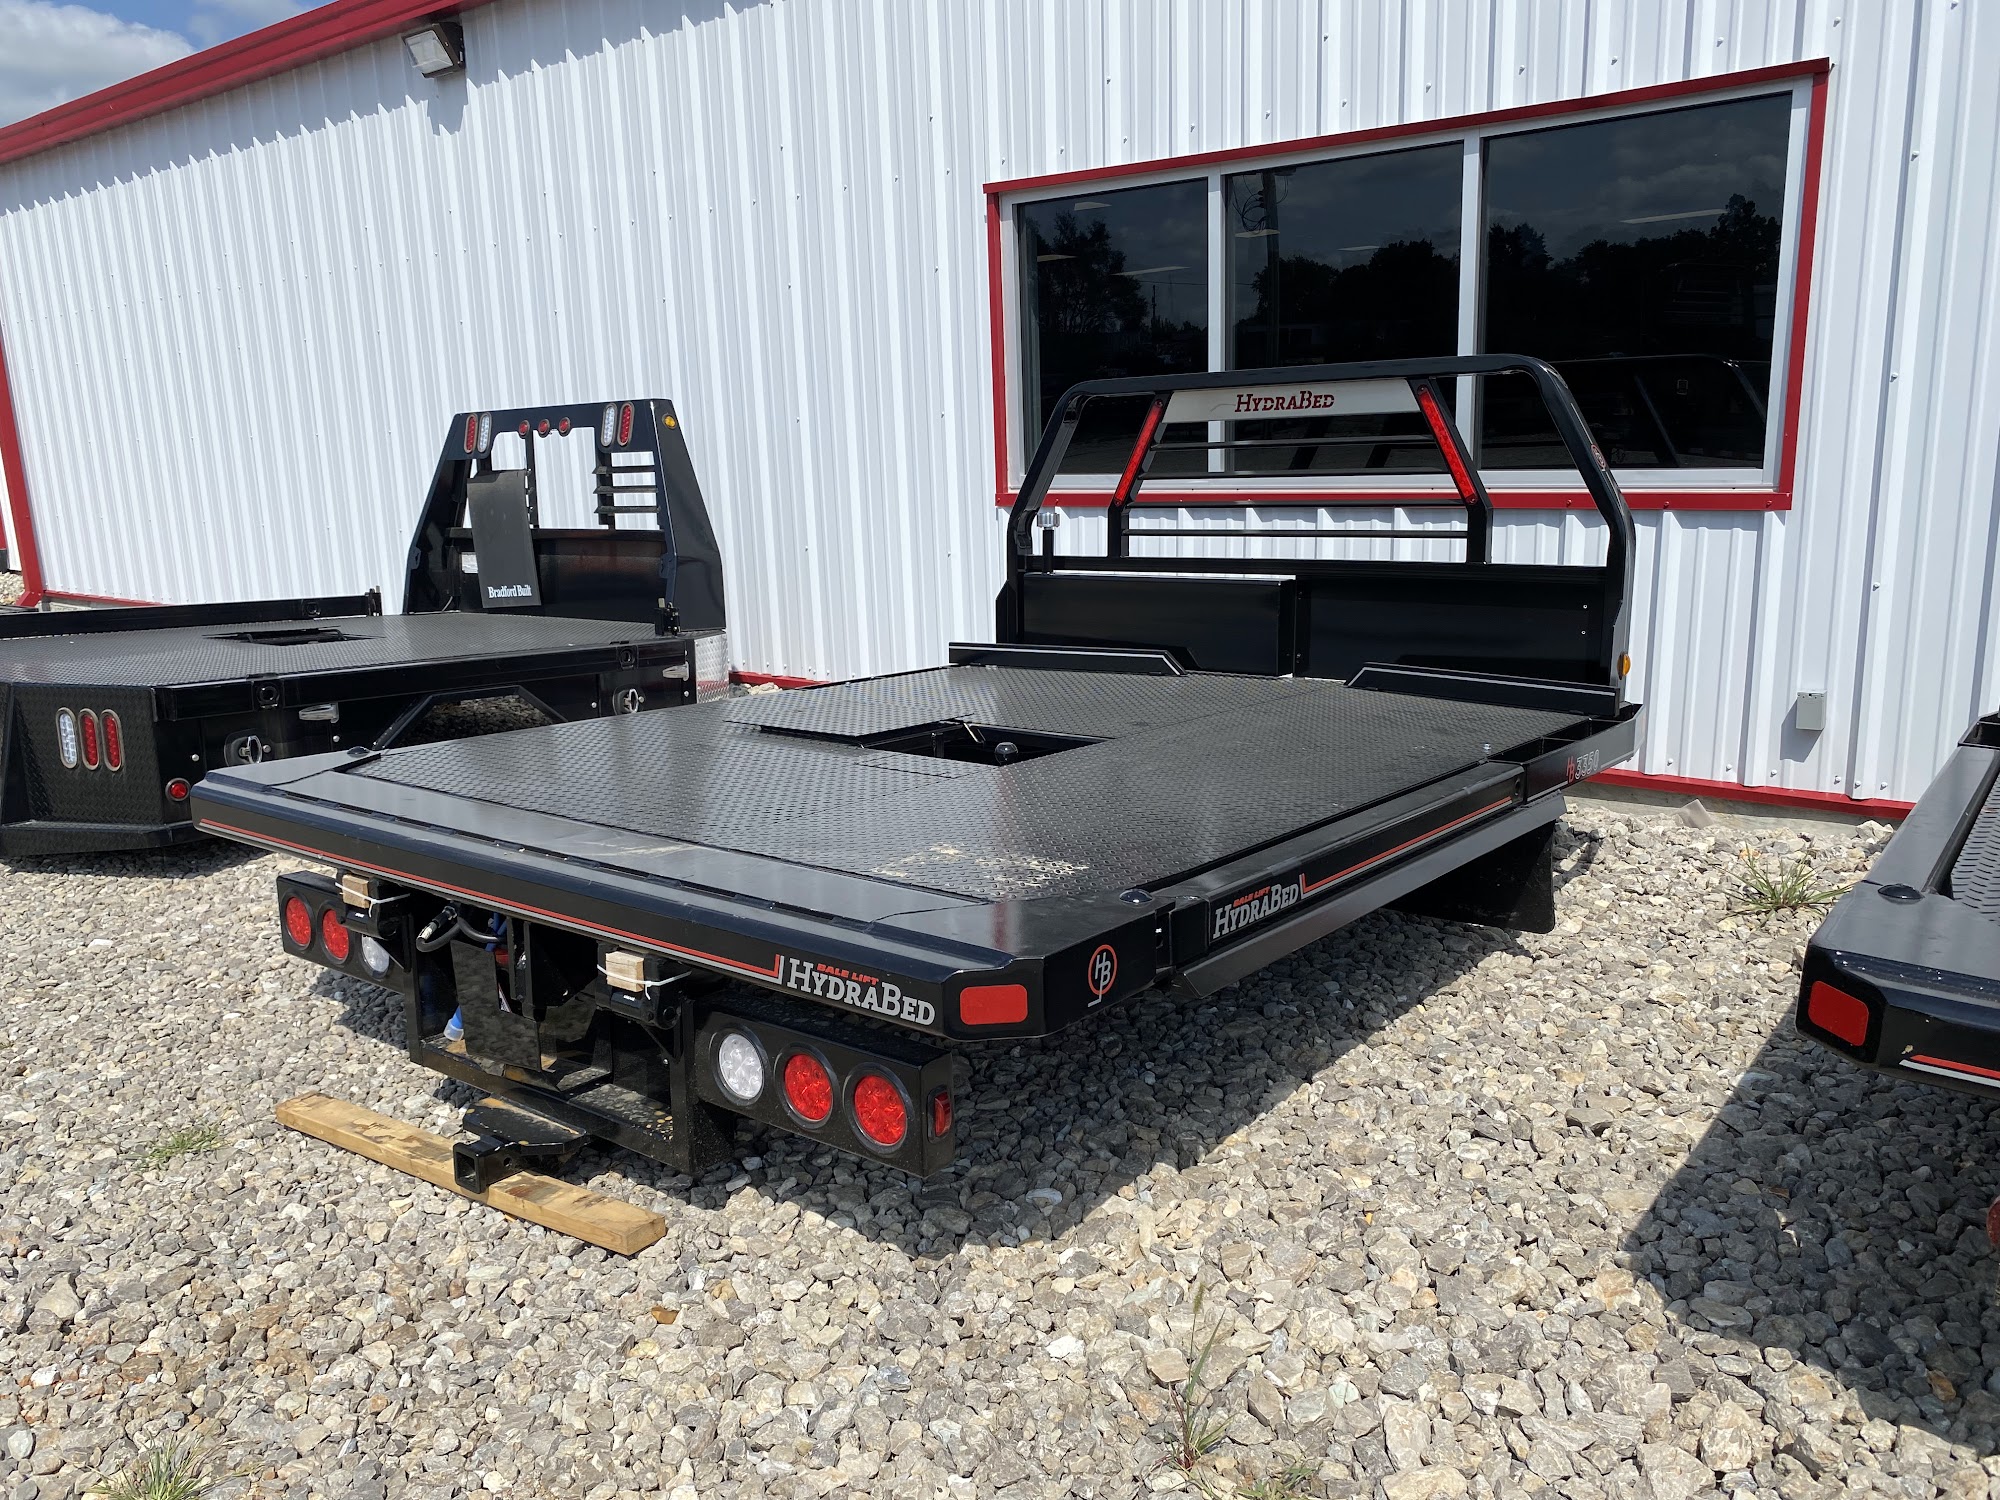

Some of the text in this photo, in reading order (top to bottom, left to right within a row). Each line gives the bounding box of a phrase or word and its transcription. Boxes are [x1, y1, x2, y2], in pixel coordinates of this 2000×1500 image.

[487, 584, 533, 599] Bradford Built
[1574, 749, 1600, 780] 3350
[1233, 893, 1254, 908] BALE
[816, 963, 880, 986] BALE LIFT
